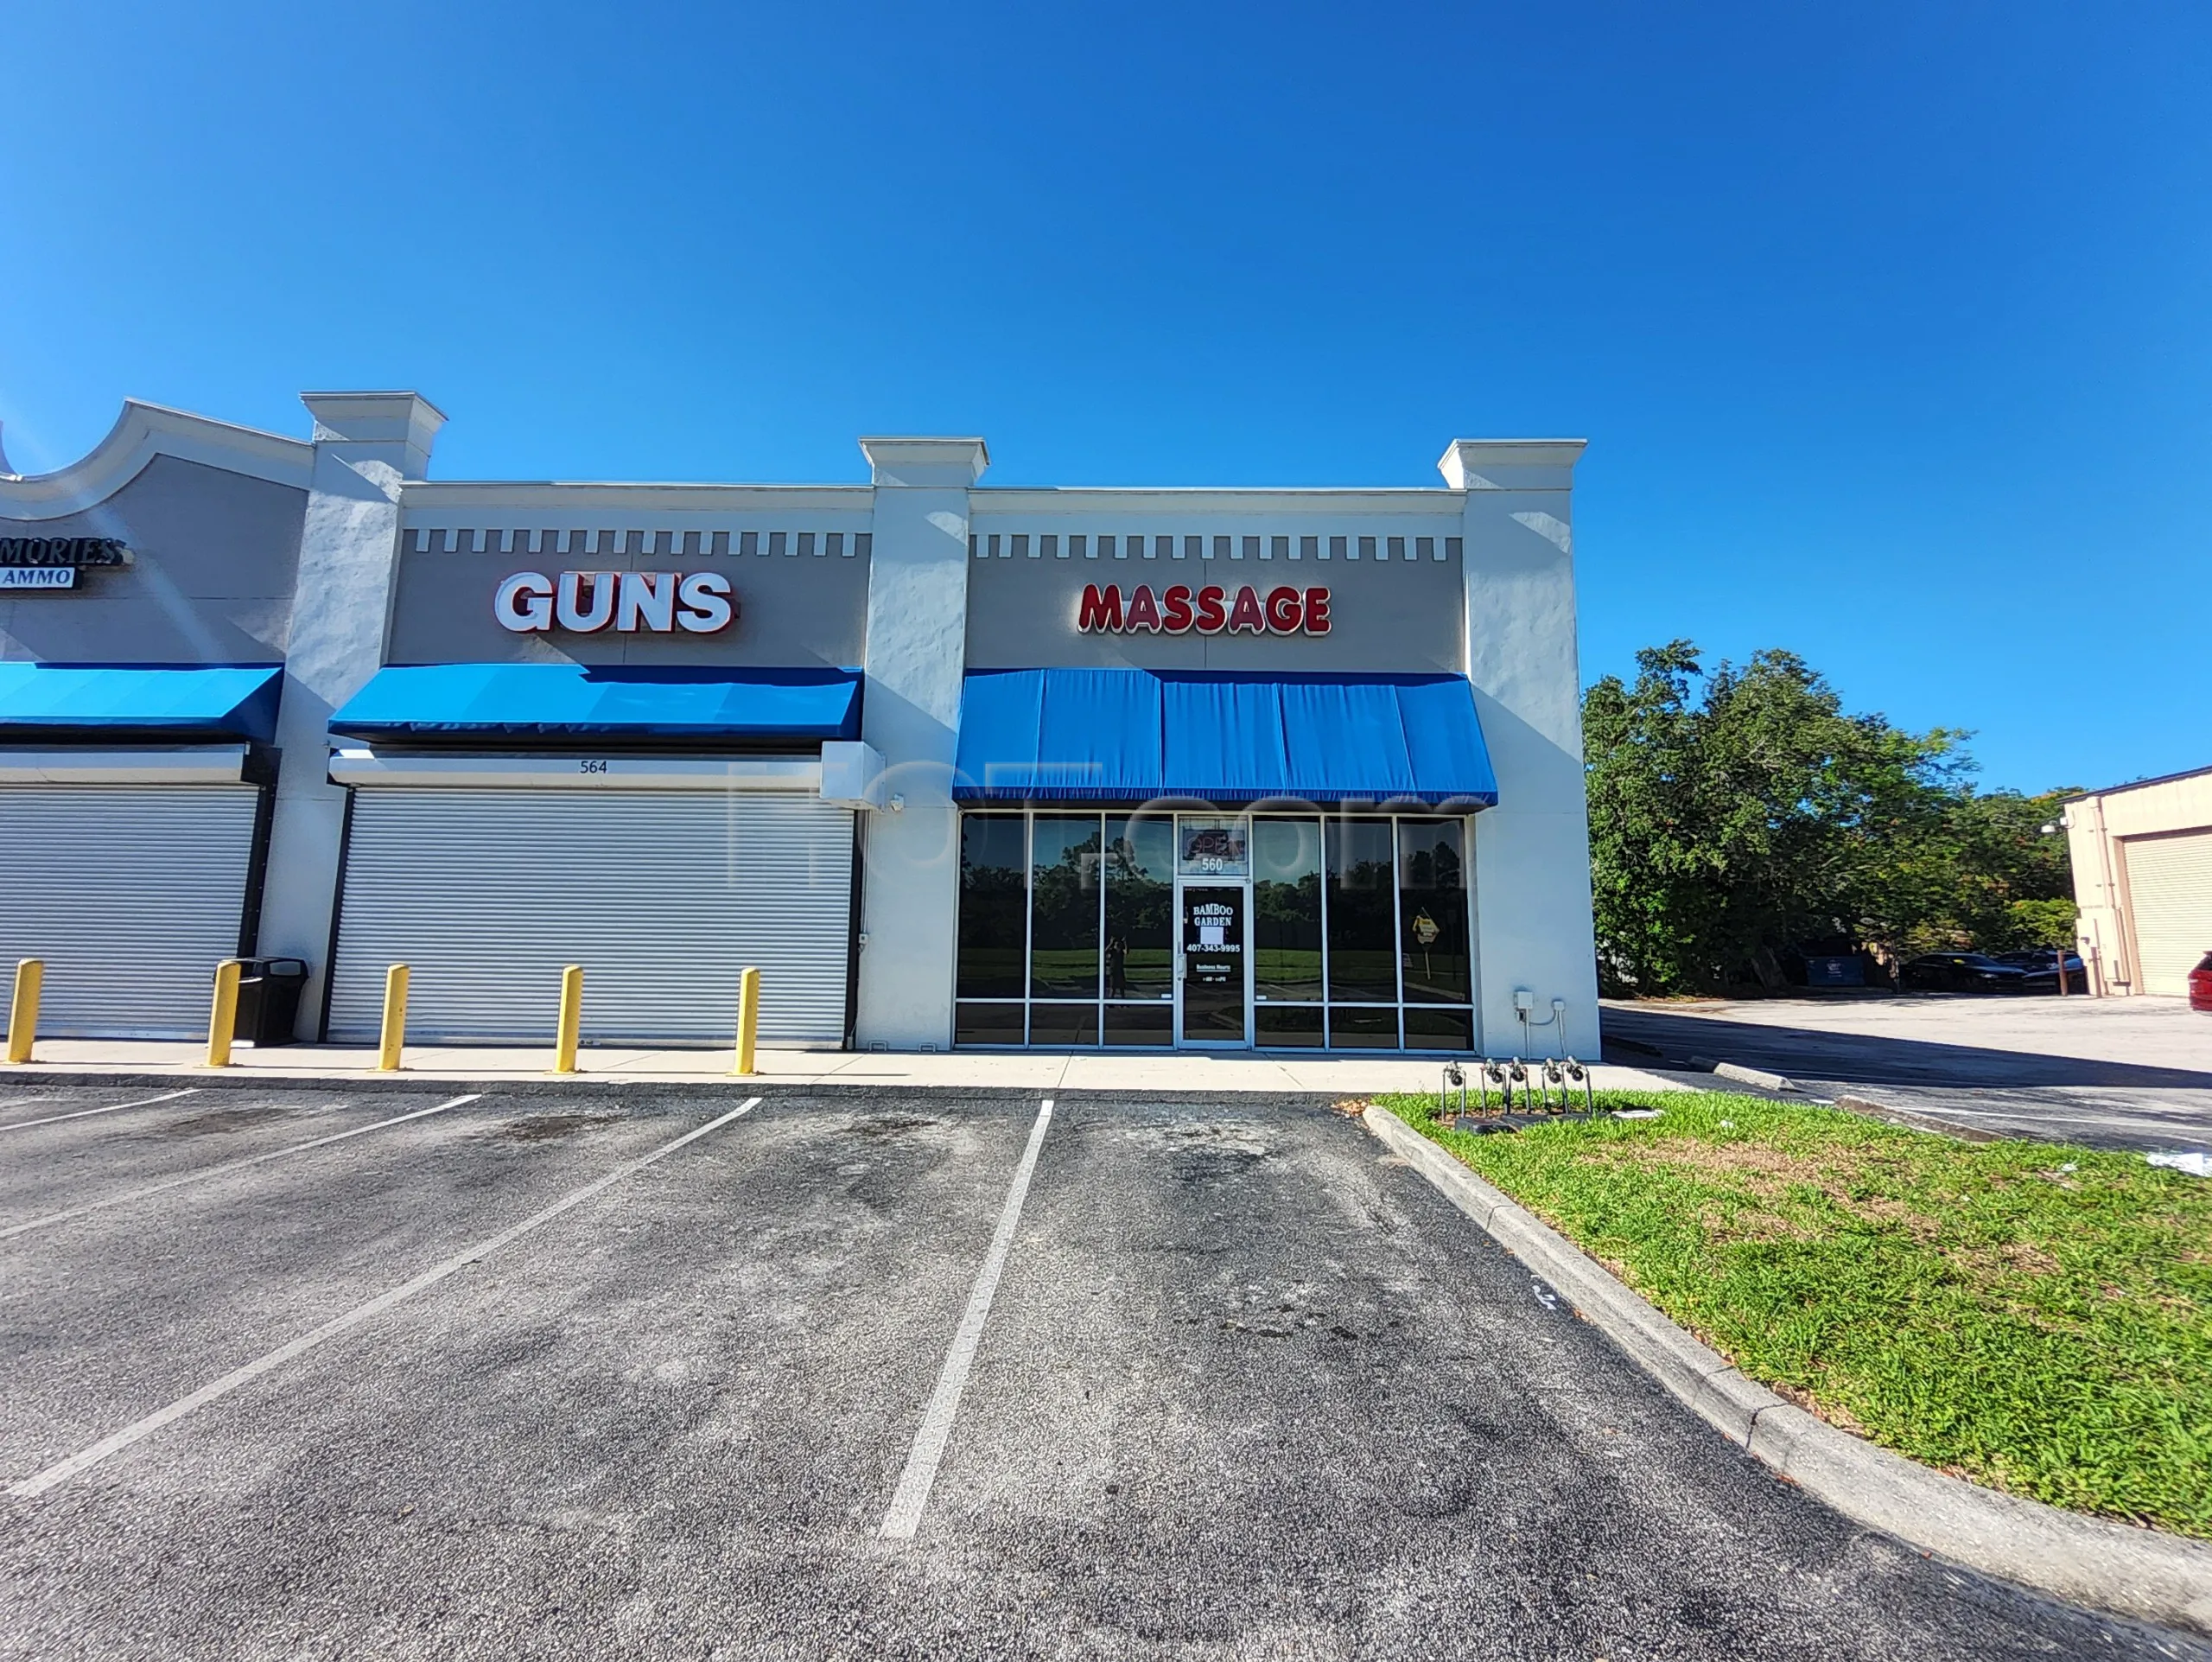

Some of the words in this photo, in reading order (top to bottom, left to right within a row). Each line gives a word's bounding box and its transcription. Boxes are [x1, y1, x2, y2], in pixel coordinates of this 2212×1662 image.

[0, 538, 121, 564] MORIES
[3, 570, 71, 584] AMMO
[494, 571, 732, 633] GUNS
[1078, 583, 1332, 635] MASSAGE
[580, 761, 607, 774] 564
[1186, 837, 1241, 855] OPEN
[1202, 857, 1223, 871] 560
[1193, 903, 1233, 915] BAMBOO
[1194, 917, 1231, 927] GARDEN
[1186, 944, 1240, 952] 407-343-9995
